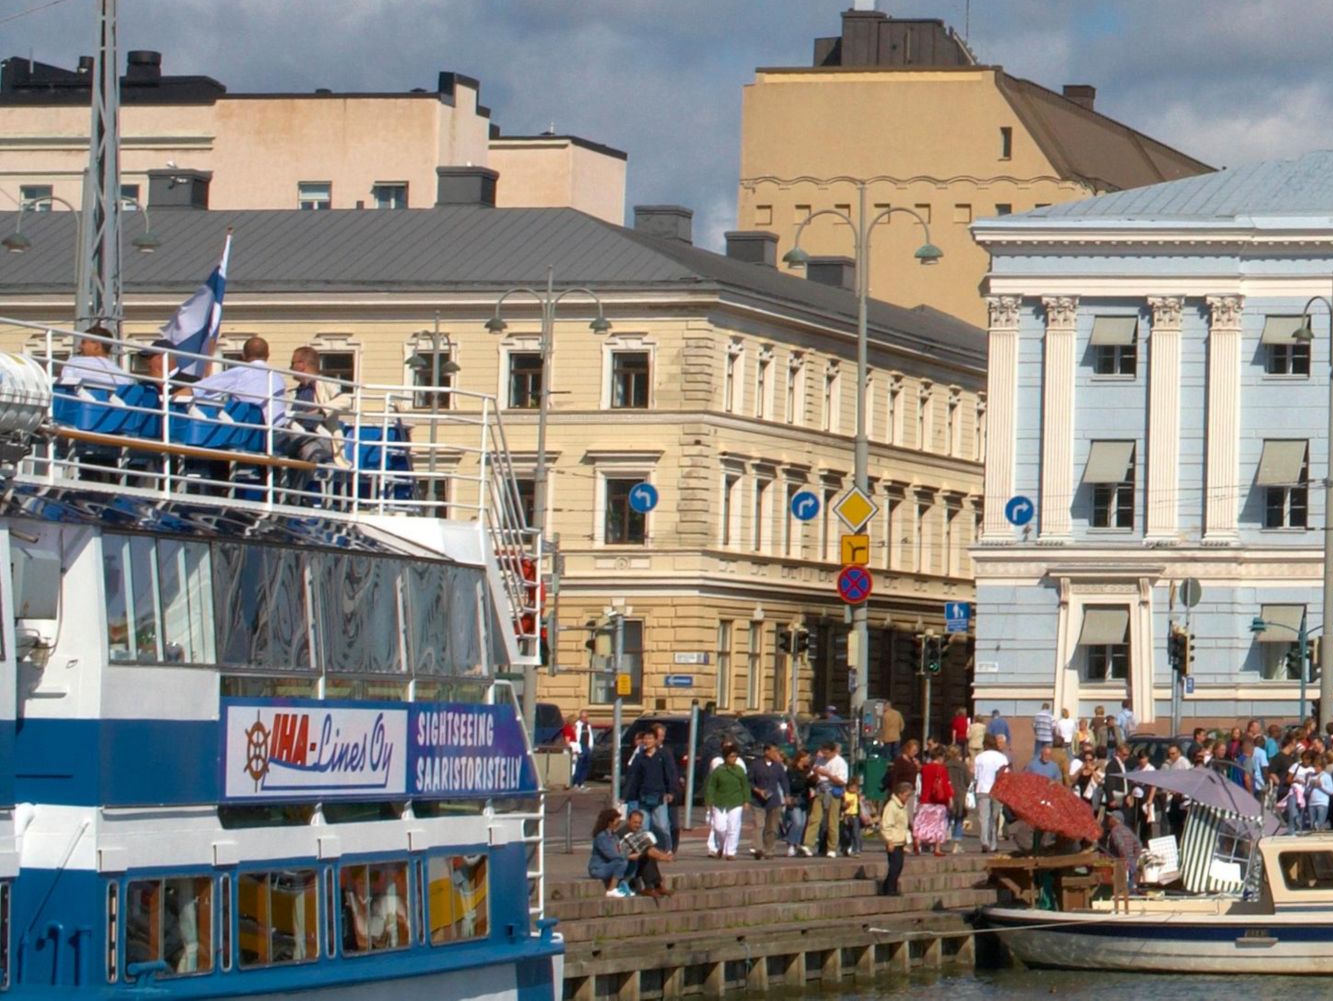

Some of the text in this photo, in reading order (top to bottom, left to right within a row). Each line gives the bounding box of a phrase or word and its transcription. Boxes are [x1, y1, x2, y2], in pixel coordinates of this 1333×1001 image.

[370, 711, 394, 775] Oy
[416, 711, 494, 747] SIGHTSEEING
[416, 754, 522, 791] SAARISTORISTEILY
